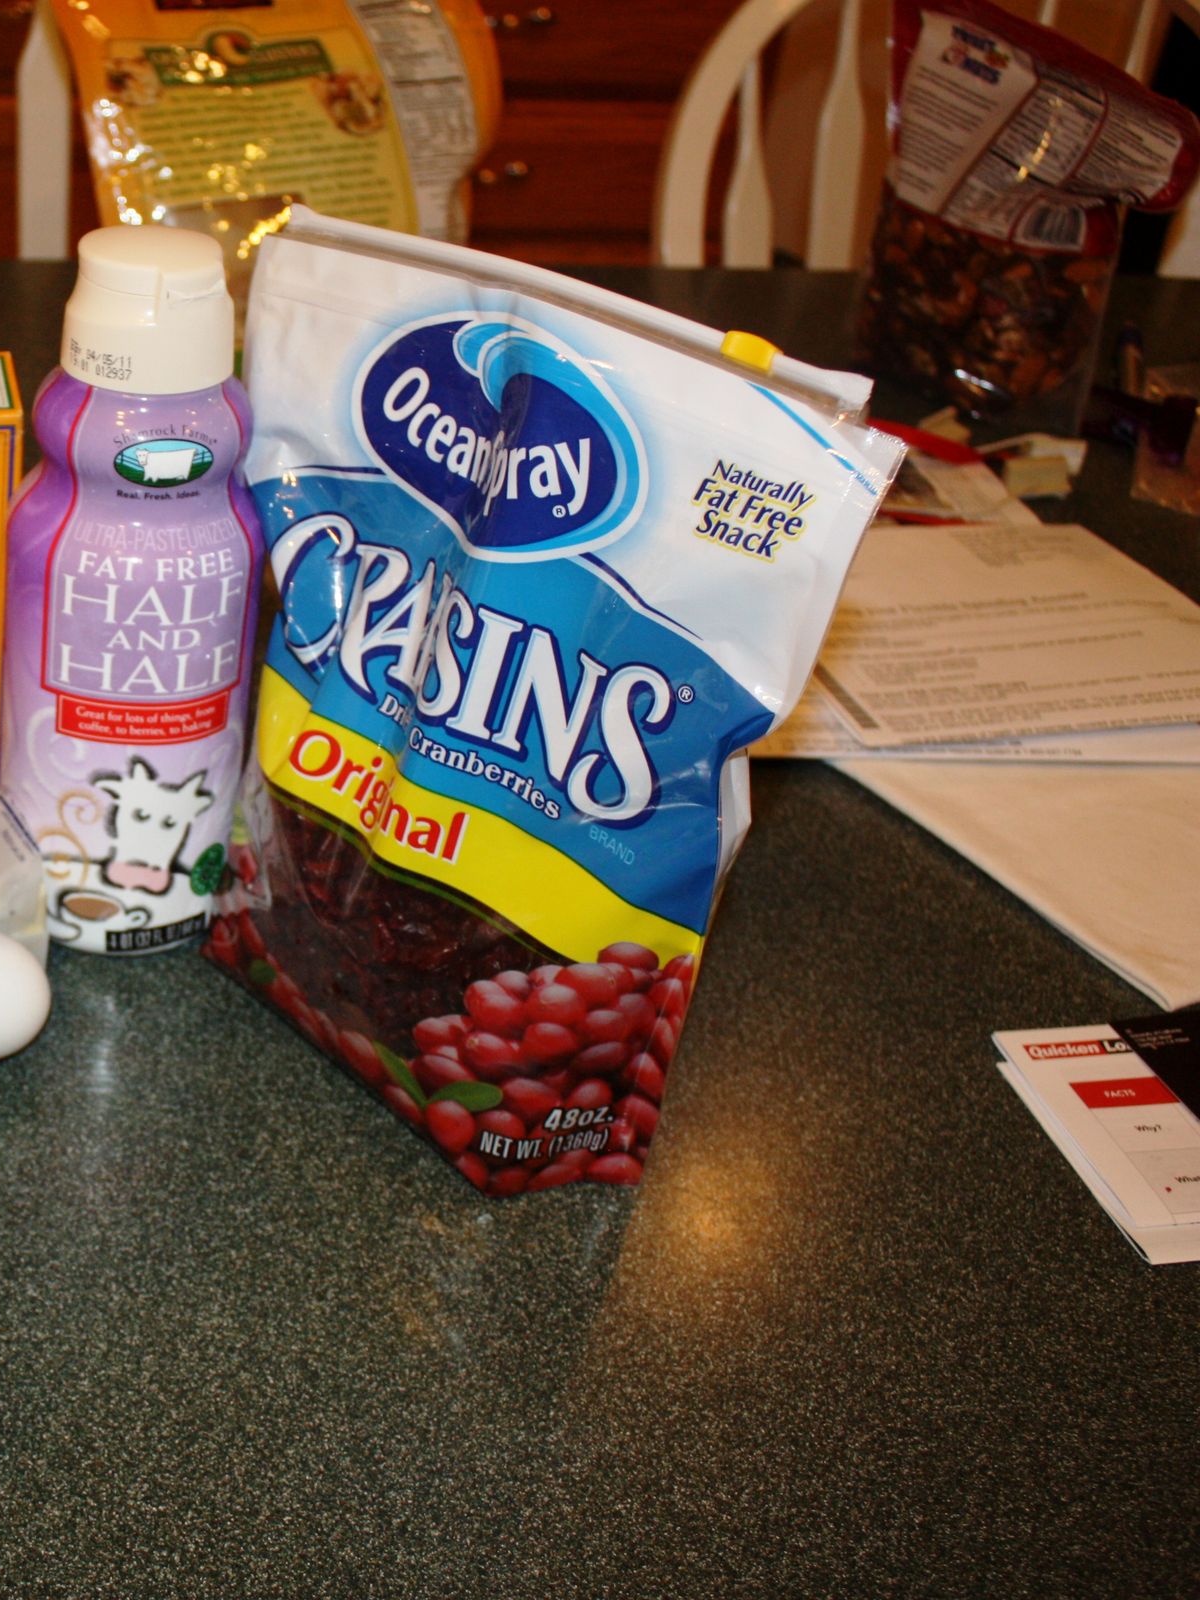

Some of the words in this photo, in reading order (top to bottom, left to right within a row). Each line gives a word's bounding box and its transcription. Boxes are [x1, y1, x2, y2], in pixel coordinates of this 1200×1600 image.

[113, 424, 176, 447] Shamrock
[182, 425, 213, 444] Farms
[383, 367, 492, 492] Ocean
[116, 489, 141, 500] Real.
[144, 490, 172, 500] Fresh.
[712, 459, 814, 512] Naturally
[694, 478, 738, 513] Fat
[738, 495, 804, 536] Free
[73, 517, 238, 551] ULTRA-PASTEURIZED
[696, 509, 780, 558] Snack
[78, 550, 143, 582] FAT
[156, 548, 235, 582] FREE
[62, 571, 243, 626] HALF
[106, 628, 201, 651] AND
[59, 640, 236, 694] HALF
[75, 706, 105, 720] Great
[107, 710, 122, 722] for
[125, 712, 144, 723] lots
[146, 712, 158, 723] of
[78, 720, 112, 735] coffee,
[115, 724, 127, 735] to
[129, 724, 167, 737] berries,
[169, 724, 180, 735] to
[409, 727, 561, 820] Cranberries
[288, 728, 470, 865] Orignal
[588, 825, 635, 866] BRAND
[1029, 1041, 1100, 1060] Quicken
[1103, 1039, 1133, 1053] Lo
[1104, 1088, 1136, 1098] FACTS
[544, 1106, 614, 1131] 48oz.
[1134, 1124, 1162, 1133] Why?
[480, 1131, 513, 1159] NET
[516, 1139, 542, 1160] WT.
[549, 1127, 609, 1156] (1360g)
